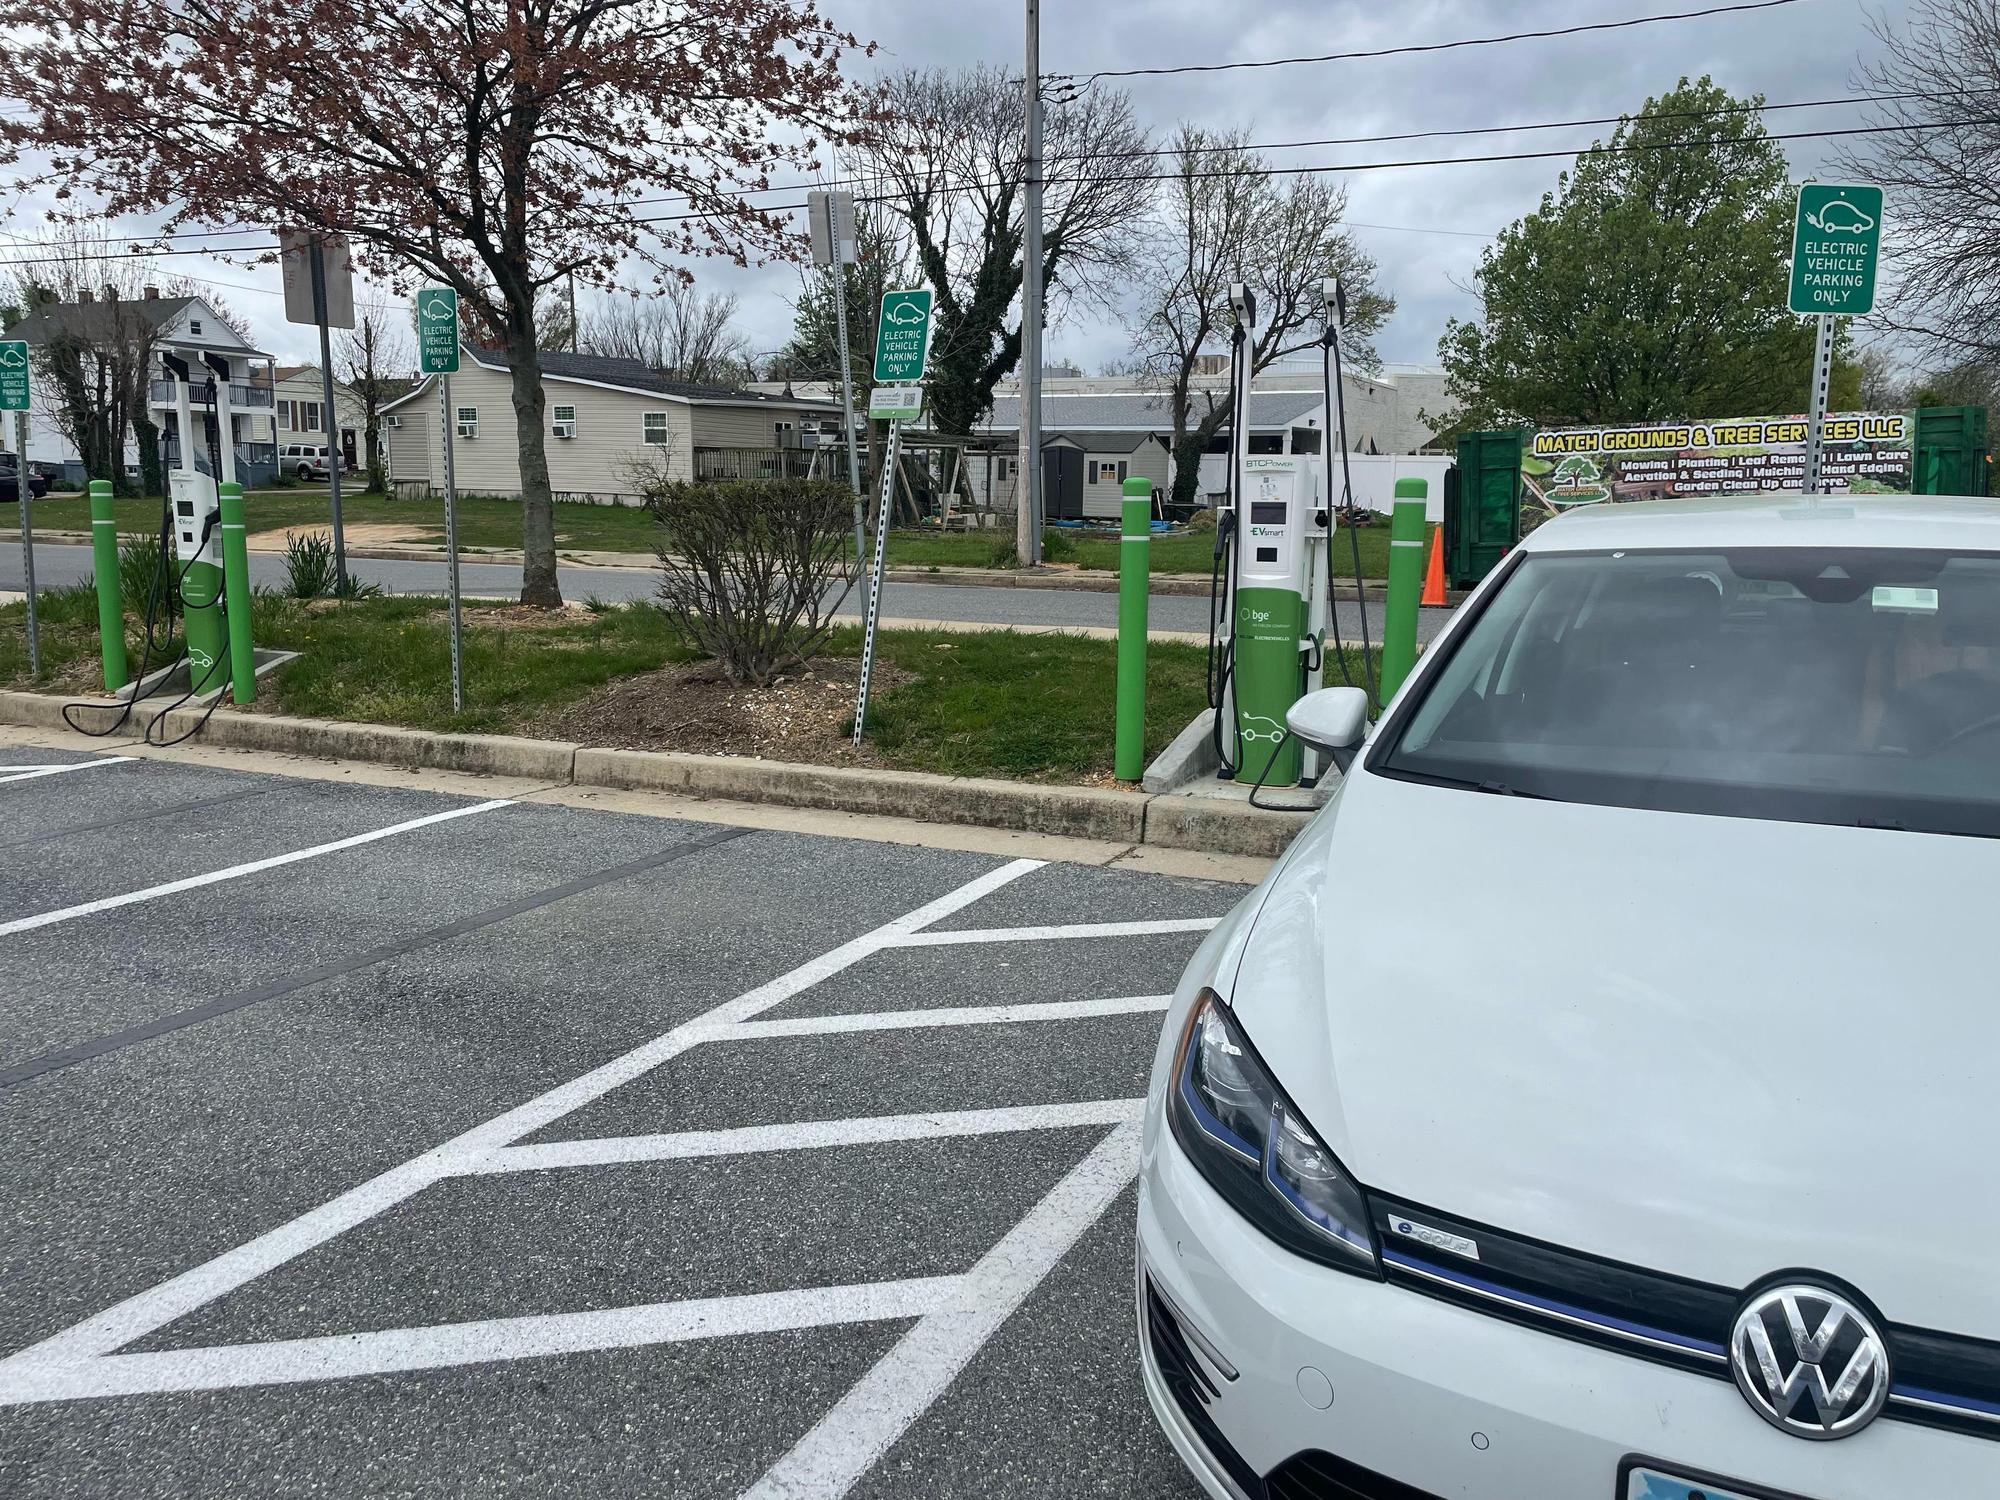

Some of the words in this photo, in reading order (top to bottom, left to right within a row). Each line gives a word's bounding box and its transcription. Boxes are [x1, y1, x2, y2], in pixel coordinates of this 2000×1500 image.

[1804, 241, 1868, 255] ELECTRIC
[1806, 257, 1864, 271] VEHICLE
[1803, 273, 1863, 286] PARKING
[1813, 289, 1851, 302] ONLY
[423, 326, 453, 335] ELECTRIC
[884, 329, 921, 340] ELECTRIC
[426, 336, 452, 345] VEHICLE
[885, 341, 918, 351] VEHICLE
[426, 347, 453, 356] PARKING
[883, 352, 918, 361] PARKING
[431, 357, 448, 366] ONLY
[888, 363, 910, 373] ONLY
[1537, 433, 1598, 453] MATCH
[1603, 429, 1688, 449] GROUNDS
[1692, 428, 1709, 447] &
[1713, 425, 1762, 445] TREE
[1766, 420, 1859, 442] SERVCES
[1863, 418, 1902, 439] LLC
[1621, 460, 1668, 470] Mowing
[1677, 458, 1729, 468] Planting
[1738, 455, 1767, 466] Leaf
[1770, 453, 1827, 465] Remol
[1836, 452, 1873, 463] Lawn
[1876, 450, 1909, 460] Care
[1624, 471, 1677, 482] Aeration
[1680, 470, 1689, 480] &
[1693, 469, 1743, 479] Seeding
[1753, 466, 1805, 477] Mulchin
[1821, 464, 1855, 475] Hand
[1859, 462, 1904, 474] Edging
[1674, 481, 1719, 491] Garden
[1722, 480, 1758, 490] Clean
[1761, 479, 1779, 490] Up
[1252, 527, 1284, 537] EVsmart
[1252, 609, 1269, 622] bge
[1397, 1222, 1470, 1252] e-GOLF
